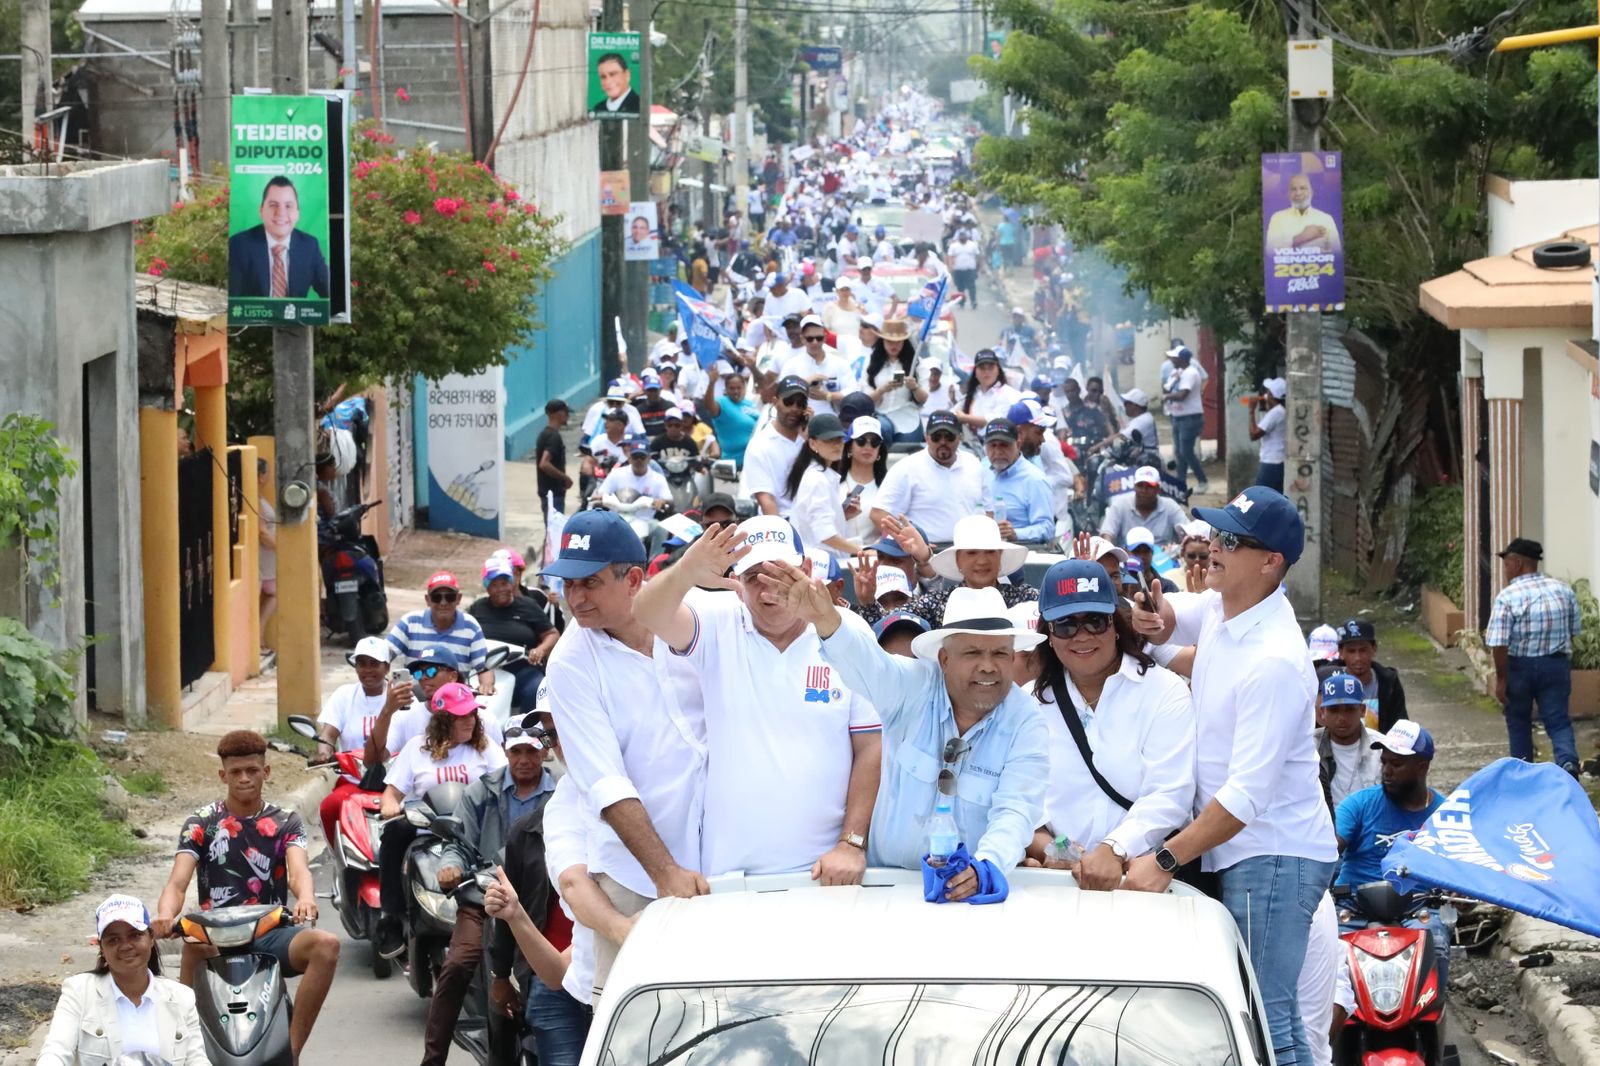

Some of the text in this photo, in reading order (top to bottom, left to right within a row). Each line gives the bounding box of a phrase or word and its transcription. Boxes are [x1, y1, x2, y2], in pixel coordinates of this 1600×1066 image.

[234, 124, 323, 141] TEIJEIRO
[235, 145, 323, 159] DIPUTADO
[287, 162, 323, 175] 2024
[1274, 242, 1321, 256] VOLVER
[1273, 254, 1335, 264] SENADOR
[1274, 263, 1335, 278] 2024
[568, 533, 591, 550] 24
[1056, 577, 1099, 596] LUIS 24
[806, 665, 830, 689] LUIS
[804, 687, 830, 703] 24
[1324, 681, 1336, 695] KC
[209, 886, 234, 899] NIKE
